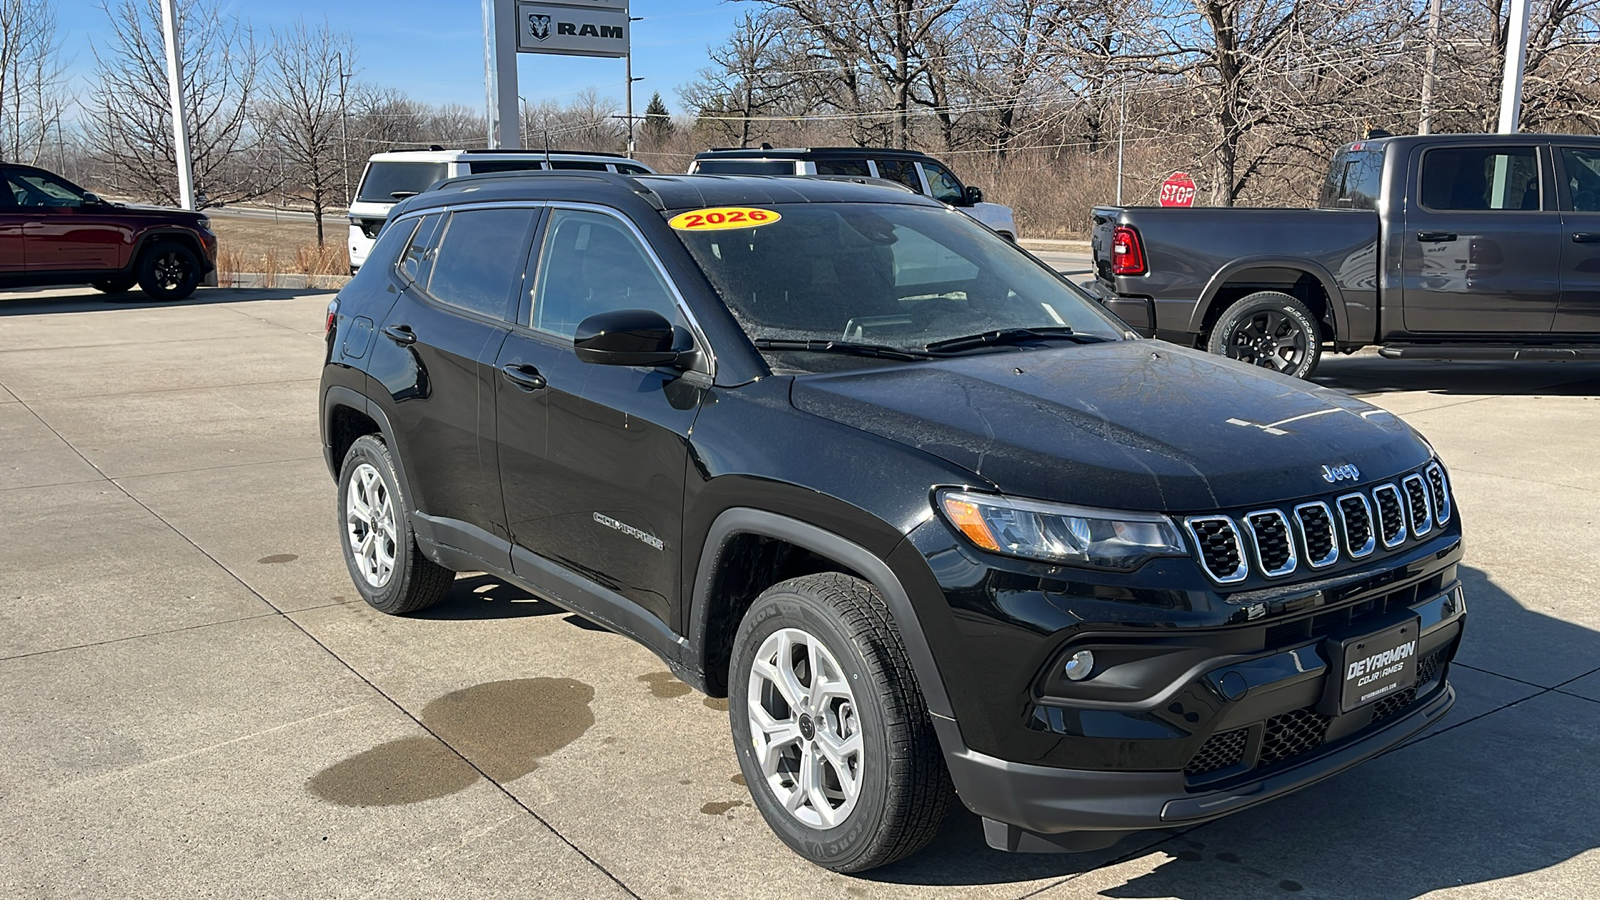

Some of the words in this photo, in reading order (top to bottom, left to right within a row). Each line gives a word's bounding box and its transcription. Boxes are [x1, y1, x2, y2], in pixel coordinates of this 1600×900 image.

[557, 22, 623, 39] RAM
[1161, 184, 1194, 204] STOP
[684, 210, 768, 228] 2026
[1321, 463, 1360, 483] Jeep
[592, 511, 664, 551] COMPASS
[1346, 640, 1415, 681] DEYARMAN
